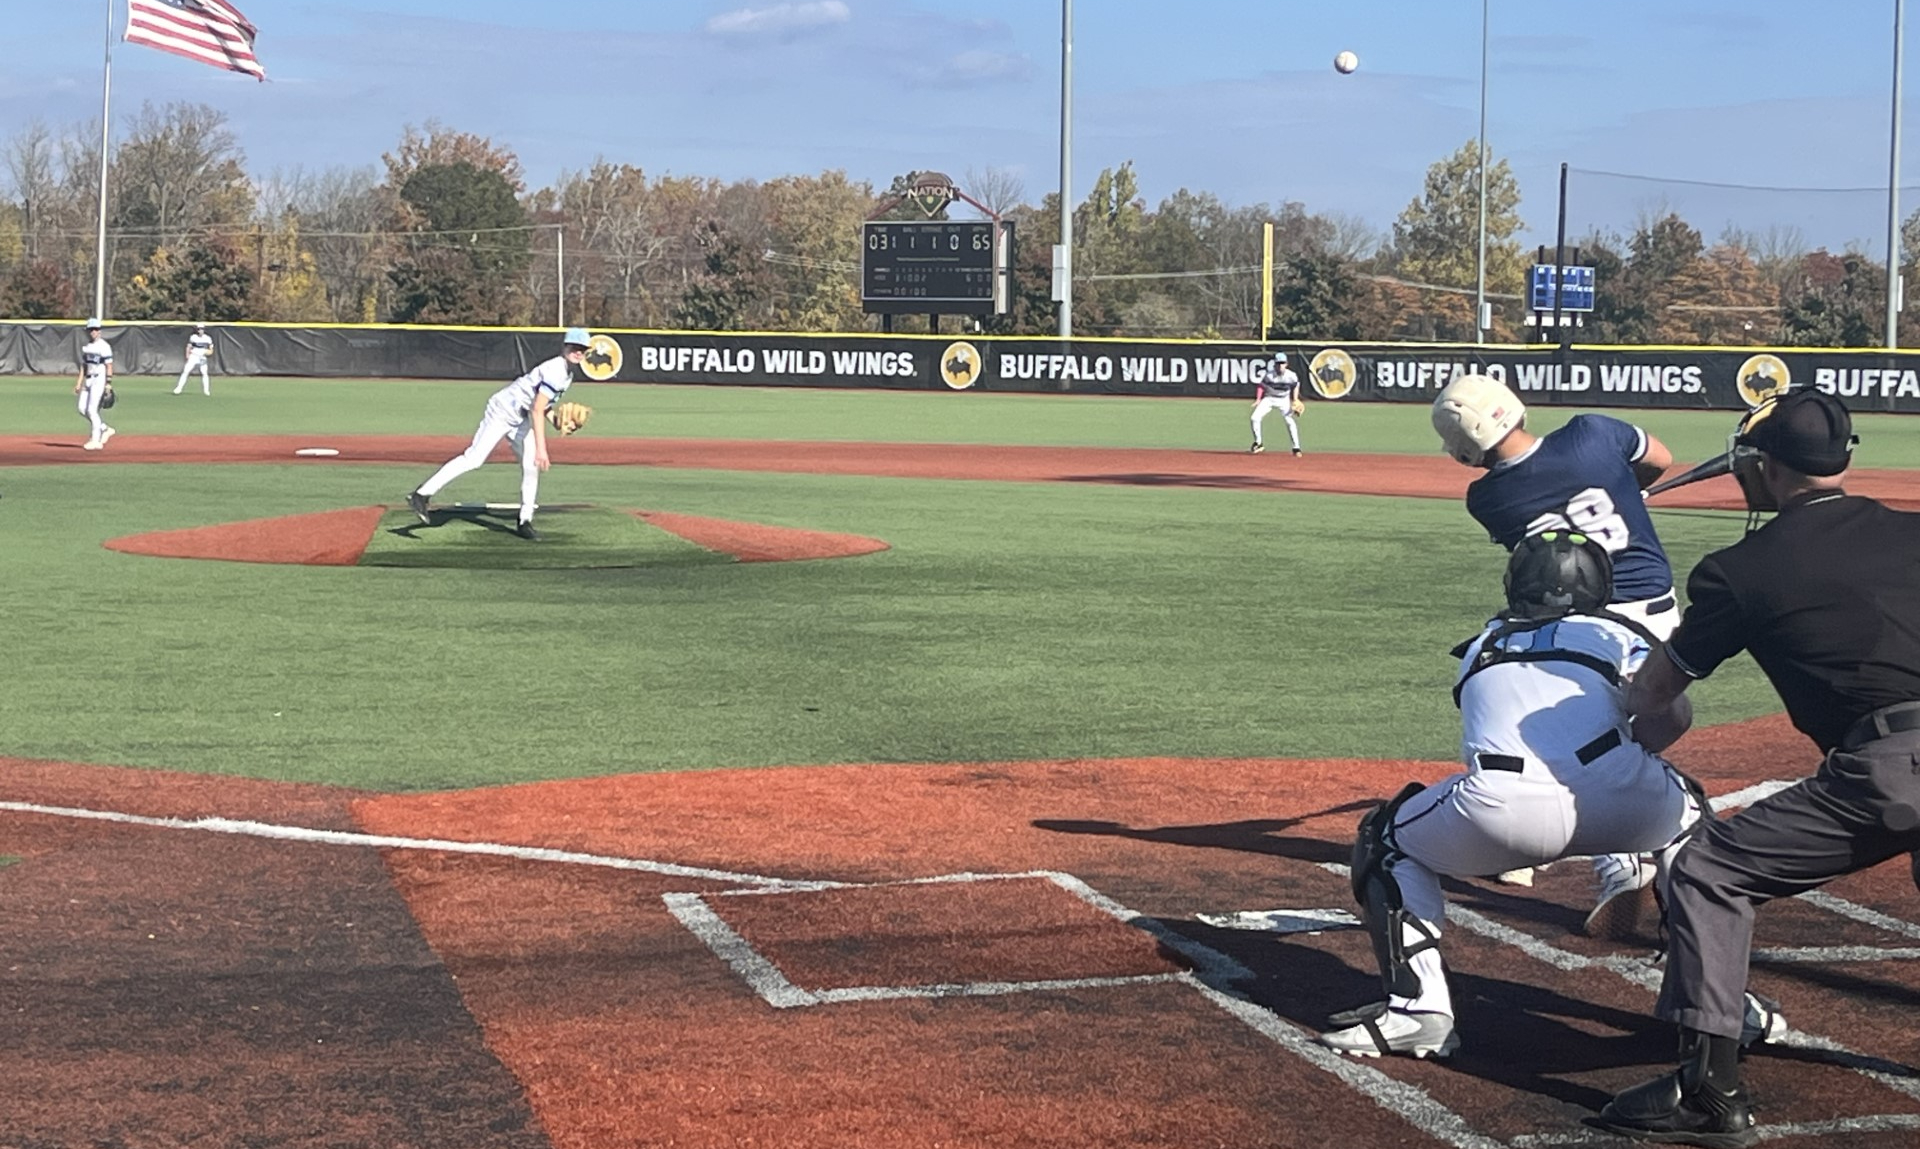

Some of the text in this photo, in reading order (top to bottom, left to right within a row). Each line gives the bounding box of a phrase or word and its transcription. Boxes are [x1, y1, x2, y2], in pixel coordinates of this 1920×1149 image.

[908, 186, 953, 199] NATION
[641, 346, 755, 374] BUFFALO
[761, 348, 827, 376] WILD
[1000, 353, 1113, 381] BUFFALO
[1120, 356, 1189, 384] WILD
[1514, 363, 1591, 391] WILD
